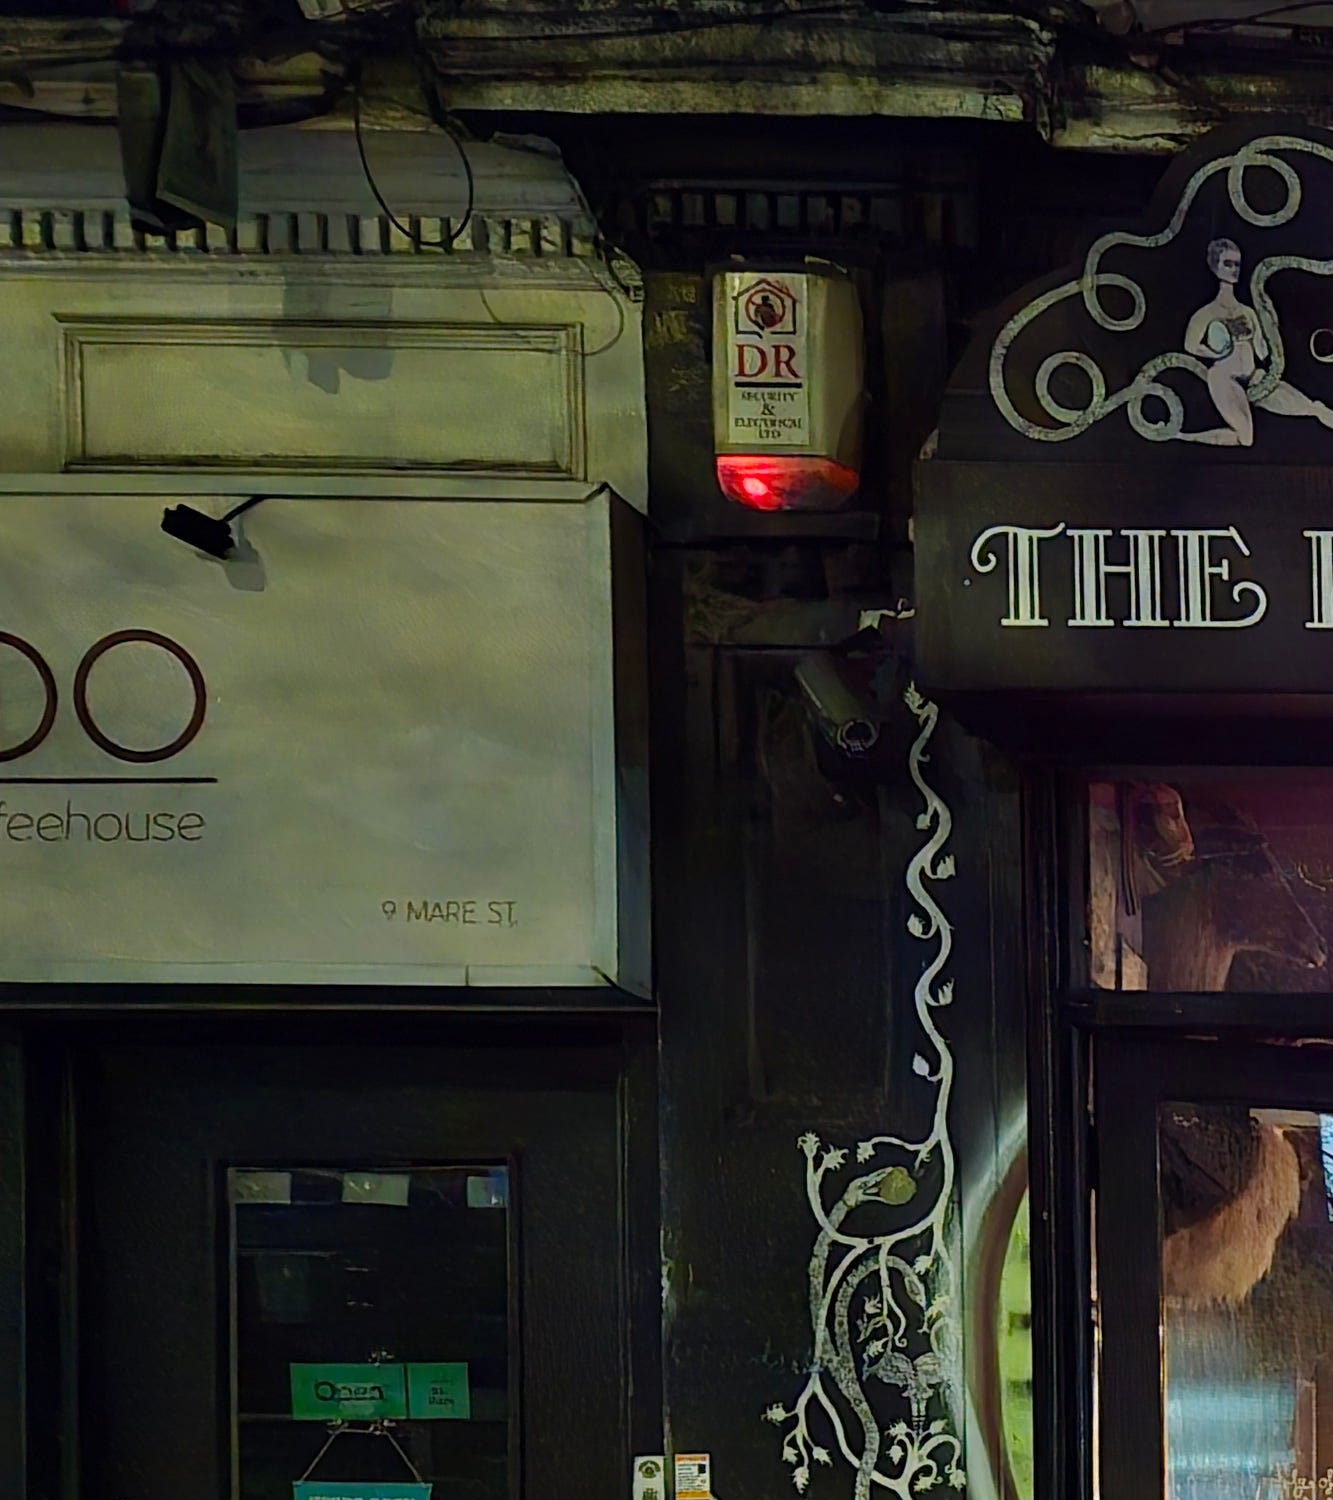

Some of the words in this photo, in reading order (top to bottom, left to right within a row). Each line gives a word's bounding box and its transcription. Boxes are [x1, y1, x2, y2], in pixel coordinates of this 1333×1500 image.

[733, 344, 801, 378] DR
[760, 402, 776, 416] &
[971, 522, 1266, 629] THE
[406, 900, 478, 924] MARE
